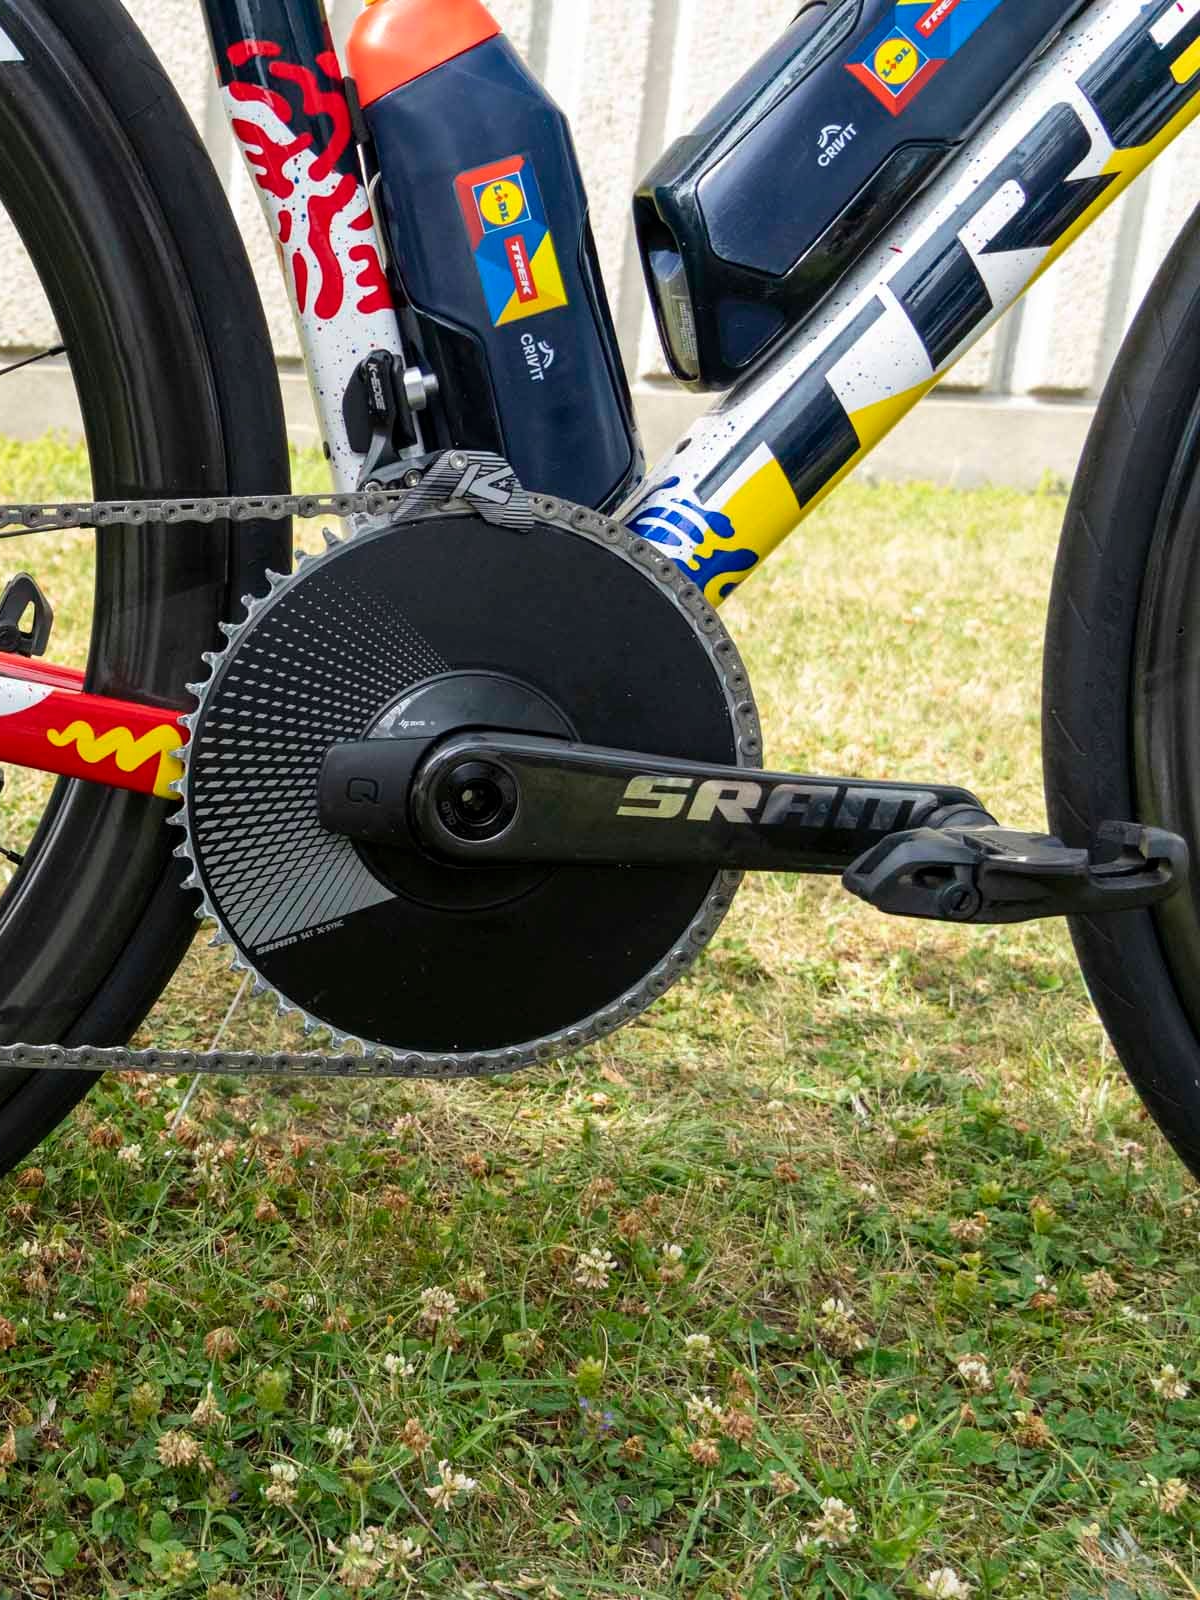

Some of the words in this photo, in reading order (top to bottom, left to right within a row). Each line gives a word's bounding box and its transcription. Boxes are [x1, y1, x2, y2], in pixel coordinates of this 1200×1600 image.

[818, 122, 856, 166] CRIVIT
[511, 241, 532, 296] TREK
[520, 333, 544, 380] CRIVIT
[616, 775, 938, 830] SRAM
